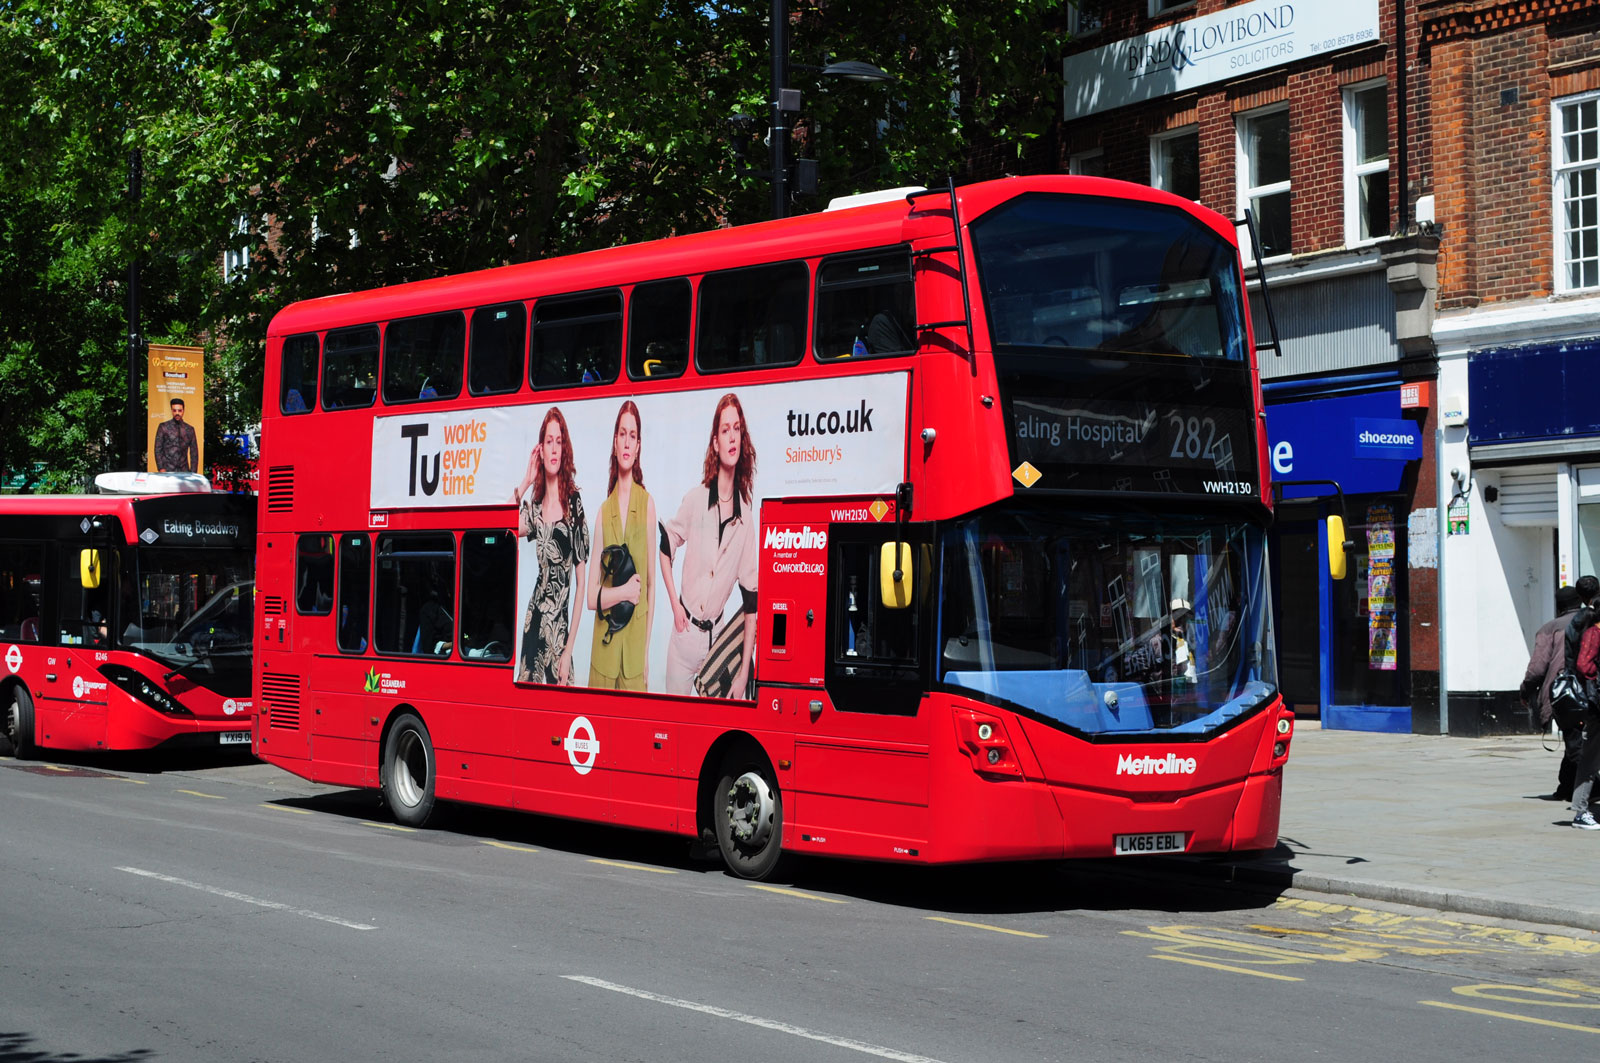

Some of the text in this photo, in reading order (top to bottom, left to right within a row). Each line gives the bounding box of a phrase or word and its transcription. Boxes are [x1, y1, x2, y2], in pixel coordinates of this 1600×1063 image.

[1128, 4, 1294, 72] BIRD & LOVIBOND
[1310, 28, 1374, 53] Tel: 020 8578 6936
[1230, 40, 1294, 69] SOLICITORS
[786, 399, 874, 437] tu.co.uk
[443, 419, 487, 445] works
[1014, 415, 1142, 448] aling Hospital
[1169, 416, 1216, 459] 282
[1359, 430, 1415, 445] shoezone
[401, 423, 441, 497] Tu
[442, 447, 482, 475] every
[785, 444, 842, 465] Sainsbury's
[442, 469, 475, 496] time
[1202, 480, 1251, 495] VWH2130
[830, 509, 868, 521] VWH2130
[164, 519, 239, 538] Ealing Broadway
[763, 526, 827, 550] Metroline
[772, 602, 788, 611] DIESEL
[772, 699, 779, 711] G
[225, 733, 243, 742] YX19
[575, 741, 589, 750] BUSES
[1116, 752, 1197, 776] Metroline
[1120, 834, 1180, 852] LK65 EBL
